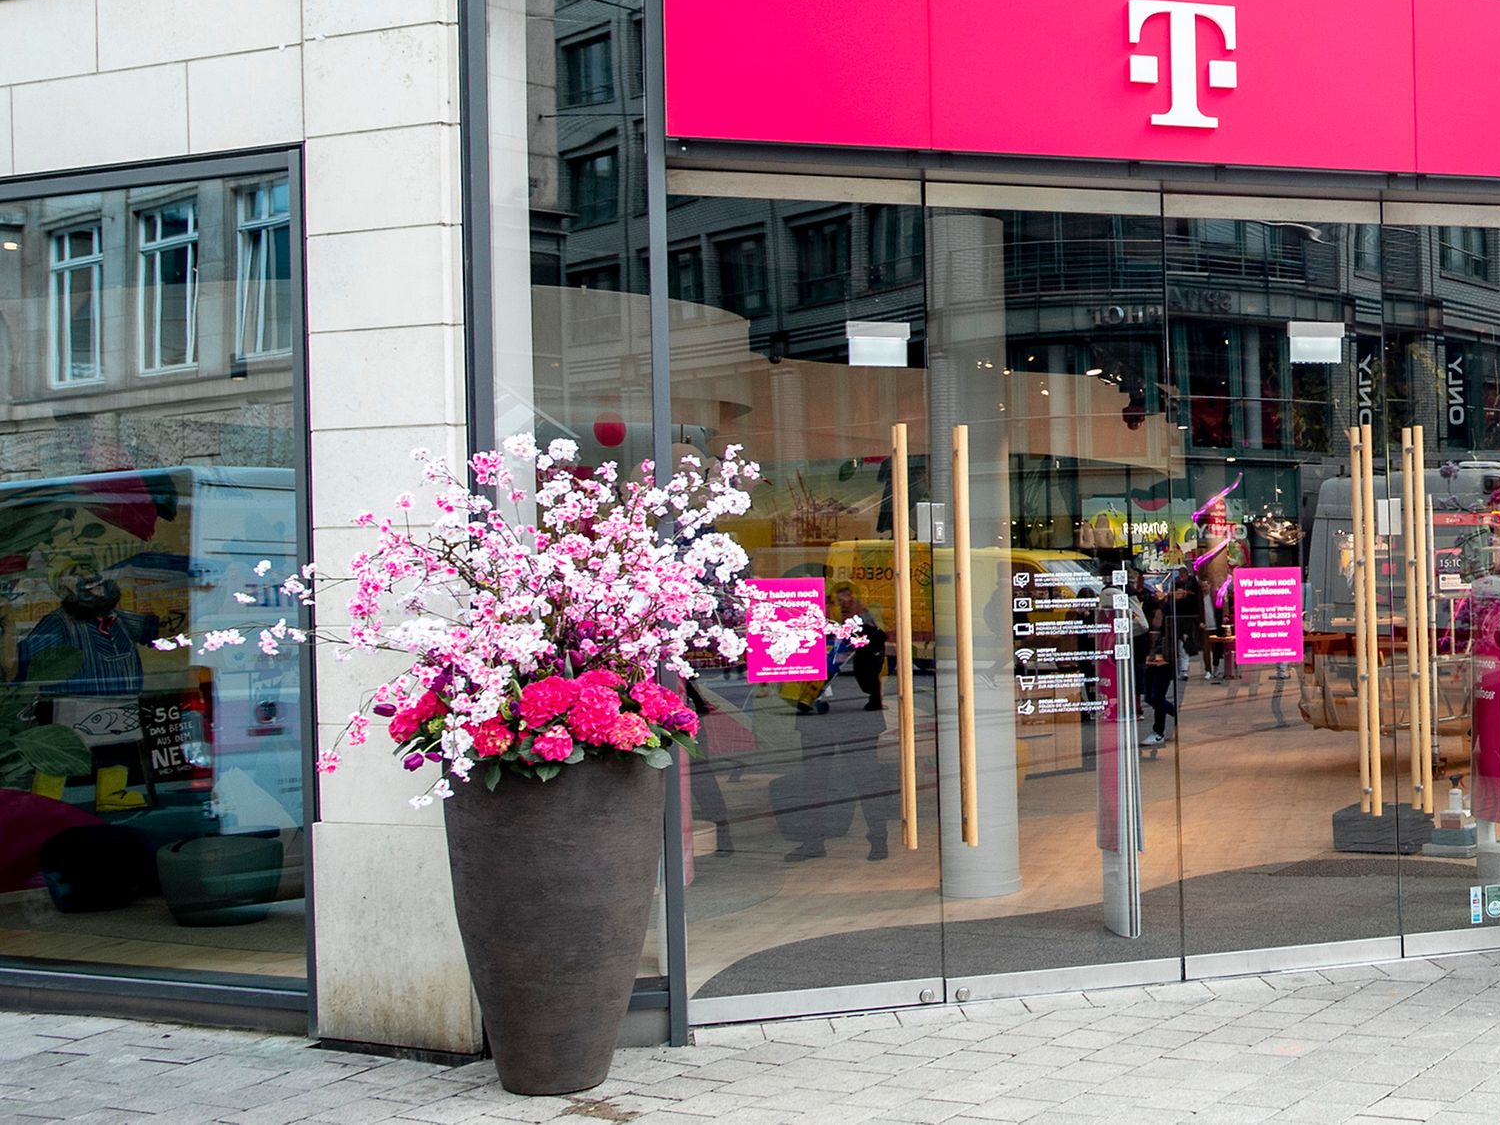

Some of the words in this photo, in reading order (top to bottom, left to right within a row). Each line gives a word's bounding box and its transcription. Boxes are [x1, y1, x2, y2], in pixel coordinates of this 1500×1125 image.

[1239, 579, 1253, 587] Wir
[1254, 578, 1277, 586] haben
[1277, 577, 1297, 586] noch
[769, 589, 797, 599] haben
[797, 588, 819, 598] noch
[154, 706, 180, 723] 5G
[149, 726, 167, 736] DAS
[168, 720, 193, 733] BESTE
[157, 736, 171, 746] AUS
[174, 732, 192, 743] DEM
